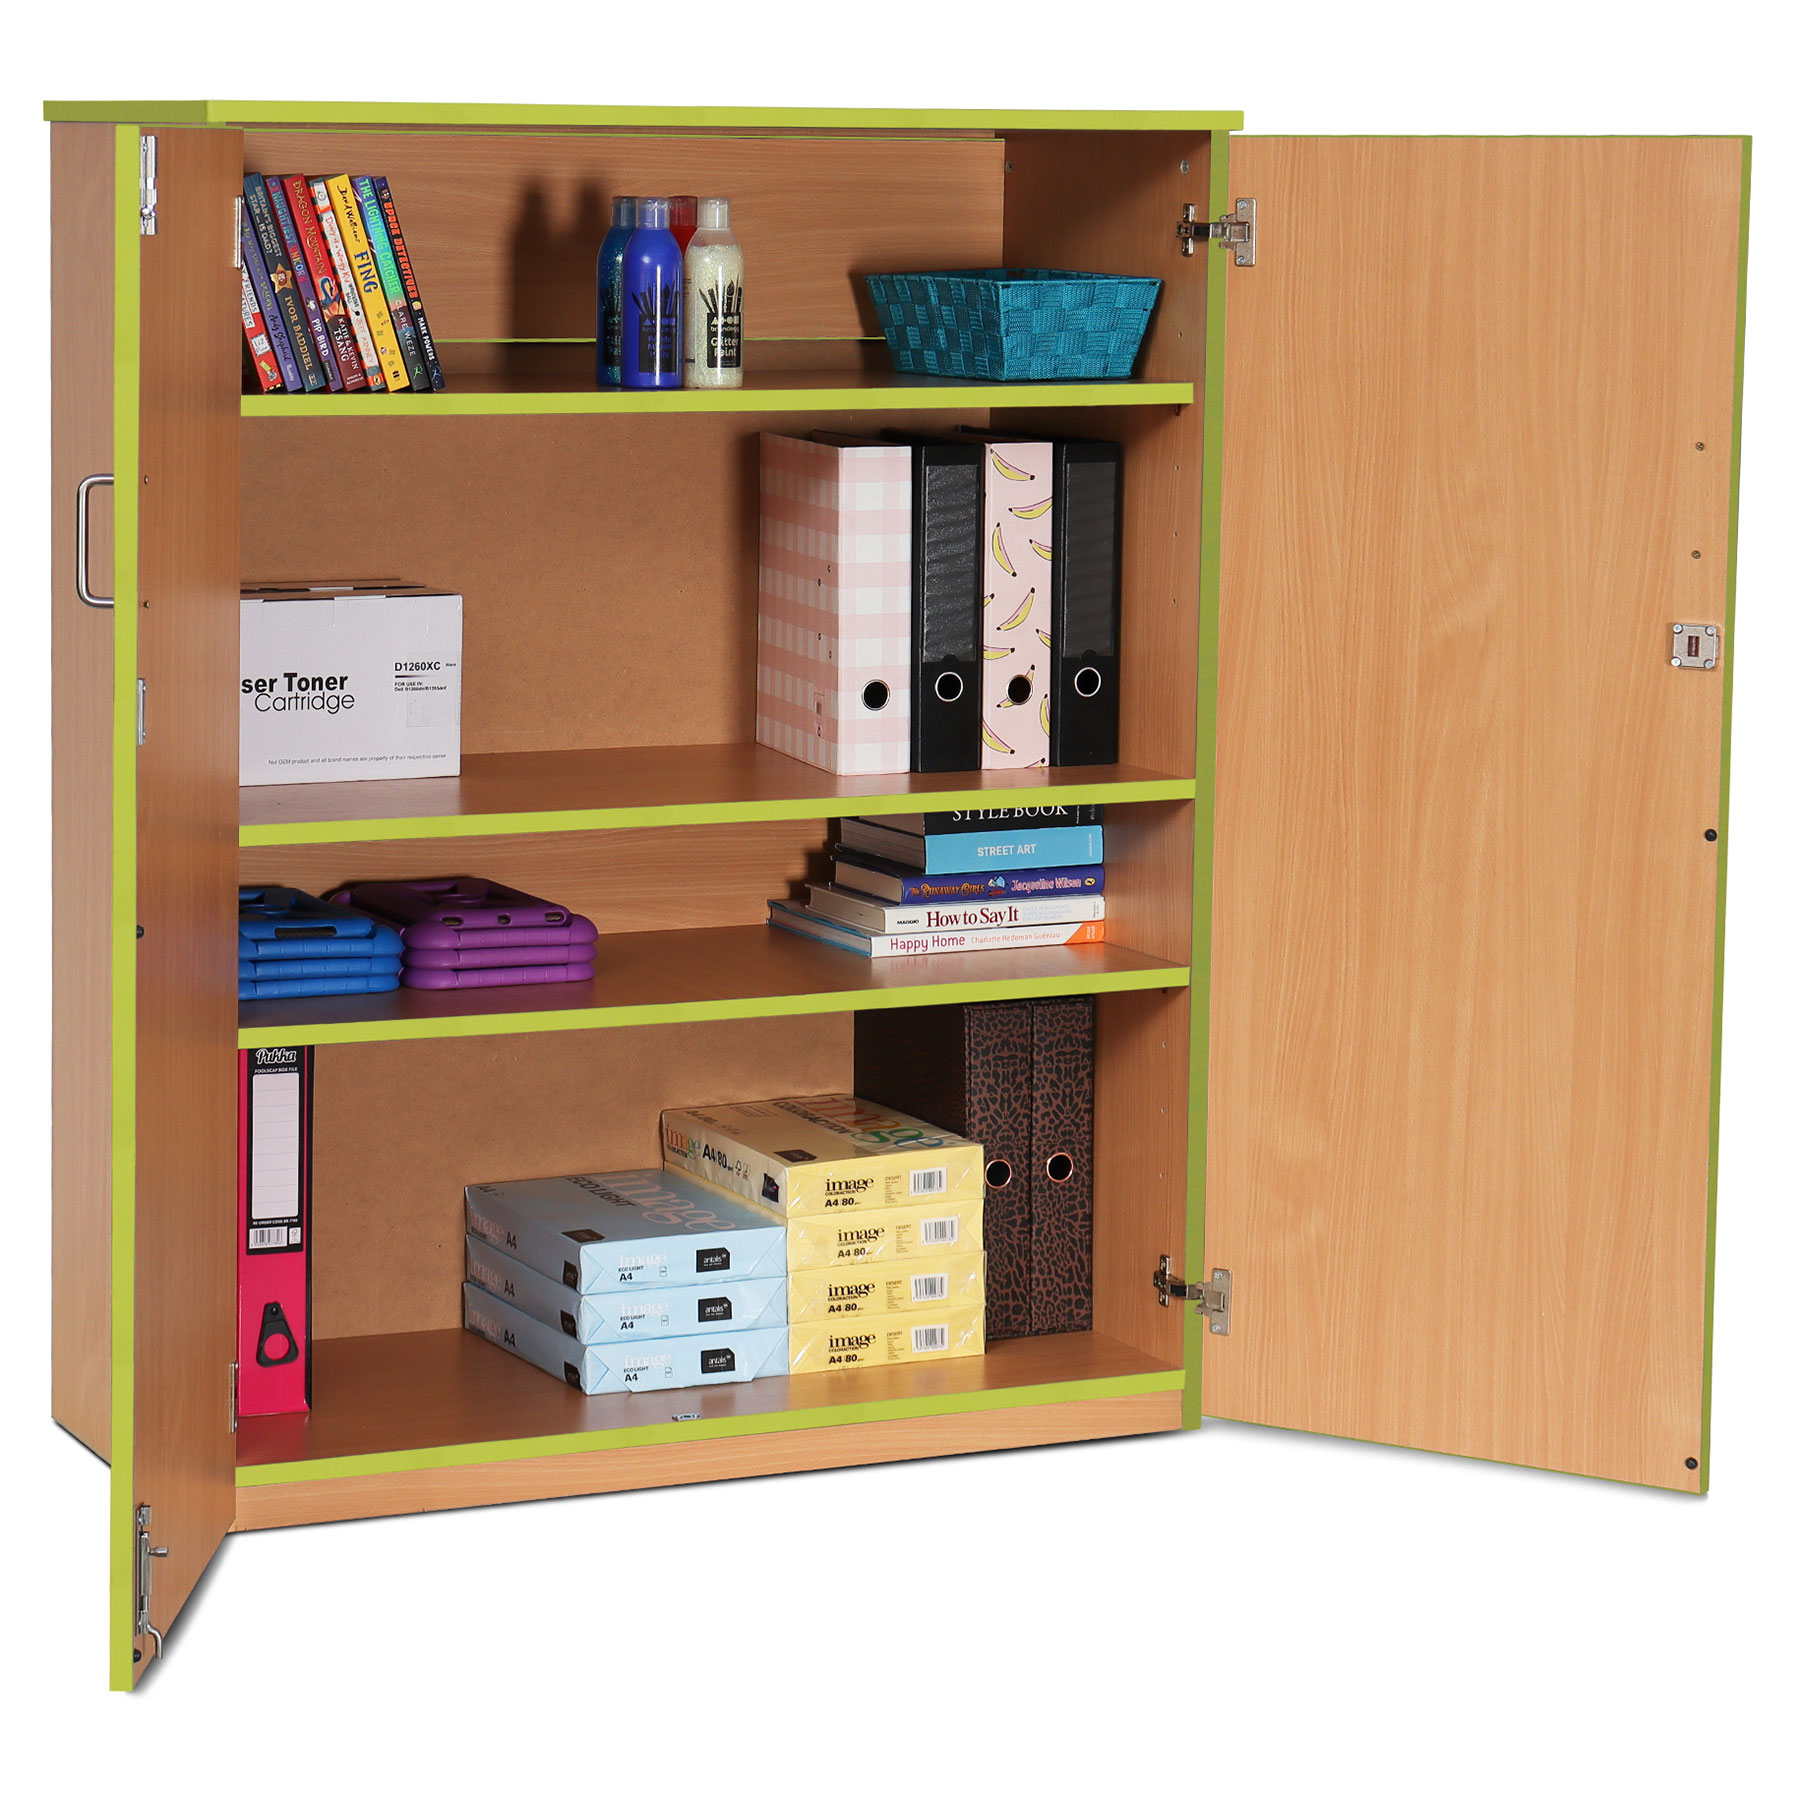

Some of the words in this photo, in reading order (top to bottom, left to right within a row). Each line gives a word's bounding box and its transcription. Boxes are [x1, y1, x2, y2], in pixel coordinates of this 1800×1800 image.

[359, 179, 373, 199] THE
[250, 194, 260, 214] STAR
[255, 186, 271, 223] BRITAIN'S
[267, 224, 282, 256] BIGGEST
[259, 223, 266, 232] IS
[293, 180, 313, 224] DRAGON
[305, 226, 327, 275] MOUNTAIN
[363, 200, 389, 250] LIGHTNING
[261, 232, 273, 254] DAD?
[325, 216, 336, 236] Diary
[336, 249, 346, 271] Wimpy
[342, 272, 351, 284] Kid
[384, 201, 400, 236] SPACE
[393, 238, 419, 299] DETECTIVES
[288, 246, 308, 282] UNICORN
[354, 250, 379, 293] FING
[380, 251, 400, 294] CATCHER
[243, 279, 258, 313] FRIENDS
[285, 296, 298, 323] IVOR
[293, 325, 313, 370] BADDIEL
[311, 318, 322, 332] PIP
[317, 334, 330, 356] BIRD
[395, 300, 409, 330] CLARE
[404, 331, 416, 357] WEZE
[417, 316, 428, 335] MARK
[423, 335, 435, 361] POWERS
[333, 327, 349, 362] TSANG
[337, 317, 349, 339] KATIE
[347, 346, 359, 370] KEVIN
[356, 318, 366, 333] JEFF
[362, 336, 374, 363] KINNEY
[394, 661, 441, 671] D1260XC
[241, 677, 278, 694] ser
[283, 672, 349, 692] Toner
[254, 690, 355, 715] Cartridge
[952, 806, 1010, 822] STYLE
[1013, 804, 1069, 817] BOOK
[977, 845, 1014, 857] STREET
[1016, 843, 1037, 855] ART
[921, 883, 960, 898] RUNAWAY
[961, 882, 986, 896] GIRLS
[1011, 878, 1054, 894] Jacqueline
[1054, 877, 1082, 889] Wilson
[926, 911, 961, 928] How
[963, 909, 978, 925] to
[979, 907, 1007, 927] Say
[1007, 905, 1019, 922] It
[890, 936, 929, 952] Happy
[932, 935, 966, 947] Home
[971, 934, 1001, 944] Charlotte
[1002, 932, 1033, 942] Hedeman
[255, 1048, 297, 1064] Pukka
[665, 1123, 701, 1160] image
[702, 1143, 716, 1162] A4
[717, 1151, 728, 1169] 80
[825, 1177, 875, 1193] image
[589, 1186, 637, 1207] LIGHT
[825, 1199, 839, 1207] A4
[841, 1197, 855, 1206] 80
[506, 1231, 517, 1249] A4
[837, 1226, 885, 1243] image
[619, 1252, 667, 1267] image
[703, 1255, 722, 1264] antalis
[837, 1250, 851, 1258] A4
[853, 1248, 866, 1256] 80
[619, 1273, 633, 1282] A4
[504, 1279, 515, 1297] A4
[828, 1281, 876, 1298] image
[620, 1302, 669, 1317] image
[705, 1305, 724, 1313] antalis
[828, 1305, 842, 1313] A4
[844, 1303, 857, 1312] 80
[621, 1321, 634, 1330] A4
[504, 1329, 516, 1348] A4
[829, 1333, 876, 1349] image
[624, 1352, 672, 1368] image
[708, 1357, 726, 1365] antalis
[828, 1355, 842, 1364] A4
[845, 1354, 858, 1362] 80
[625, 1373, 638, 1382] A4
